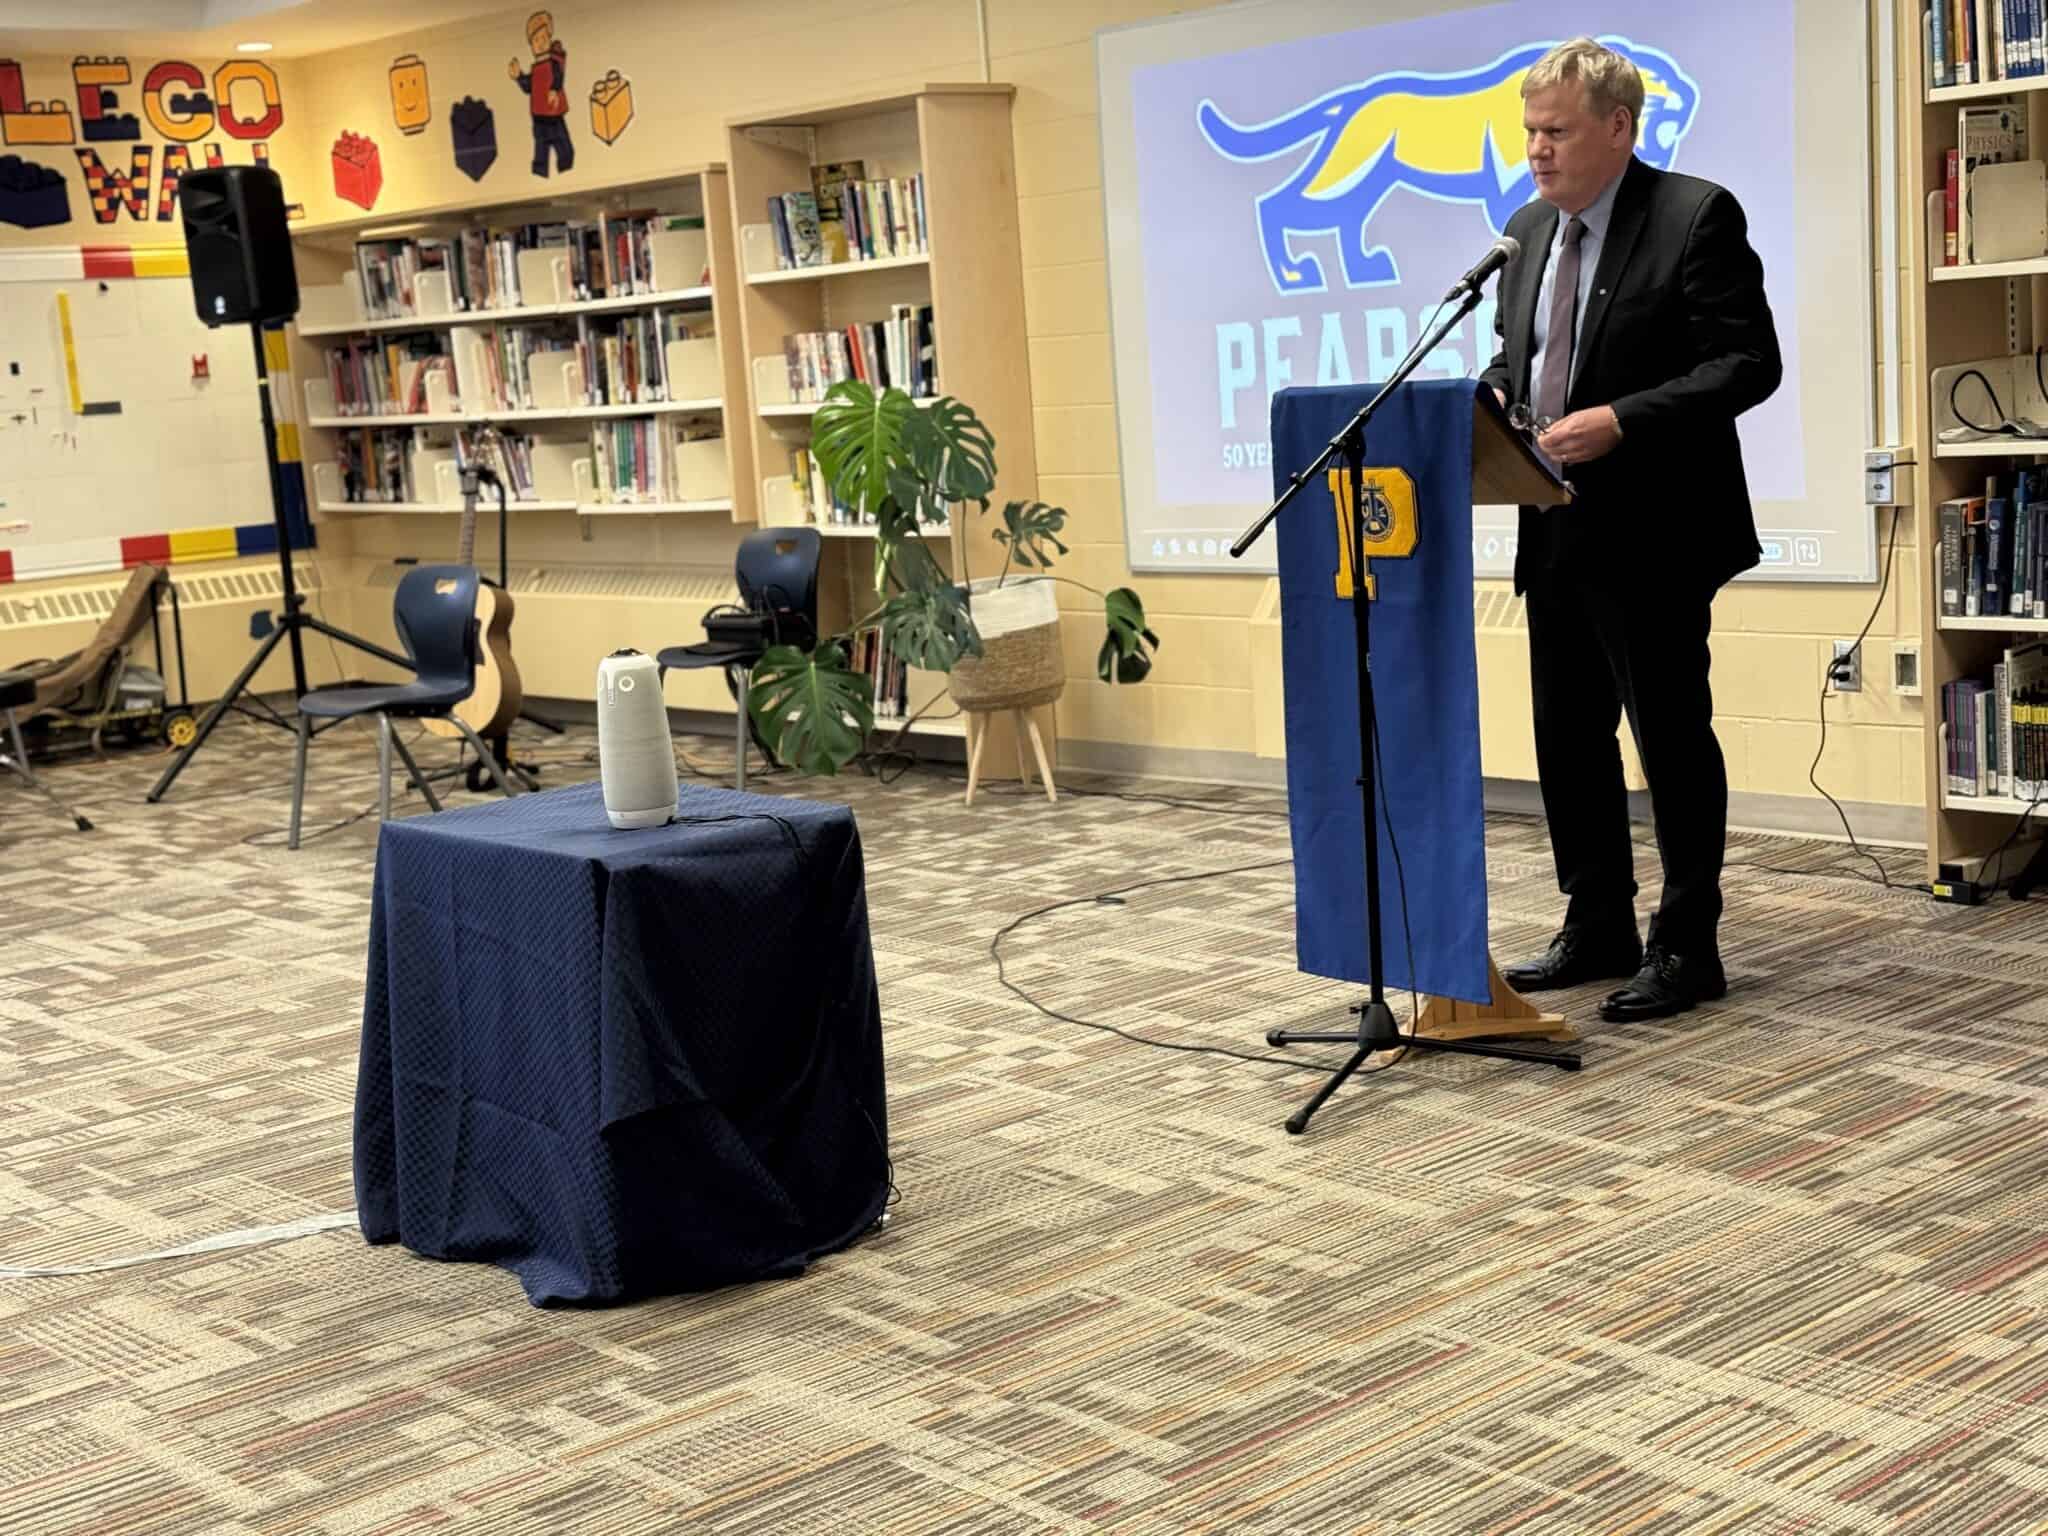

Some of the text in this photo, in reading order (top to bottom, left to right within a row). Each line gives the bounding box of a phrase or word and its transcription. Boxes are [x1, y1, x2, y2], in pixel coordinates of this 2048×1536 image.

[0, 56, 283, 145] LEGO
[74, 142, 305, 224] WA
[1223, 442, 1243, 467] 50
